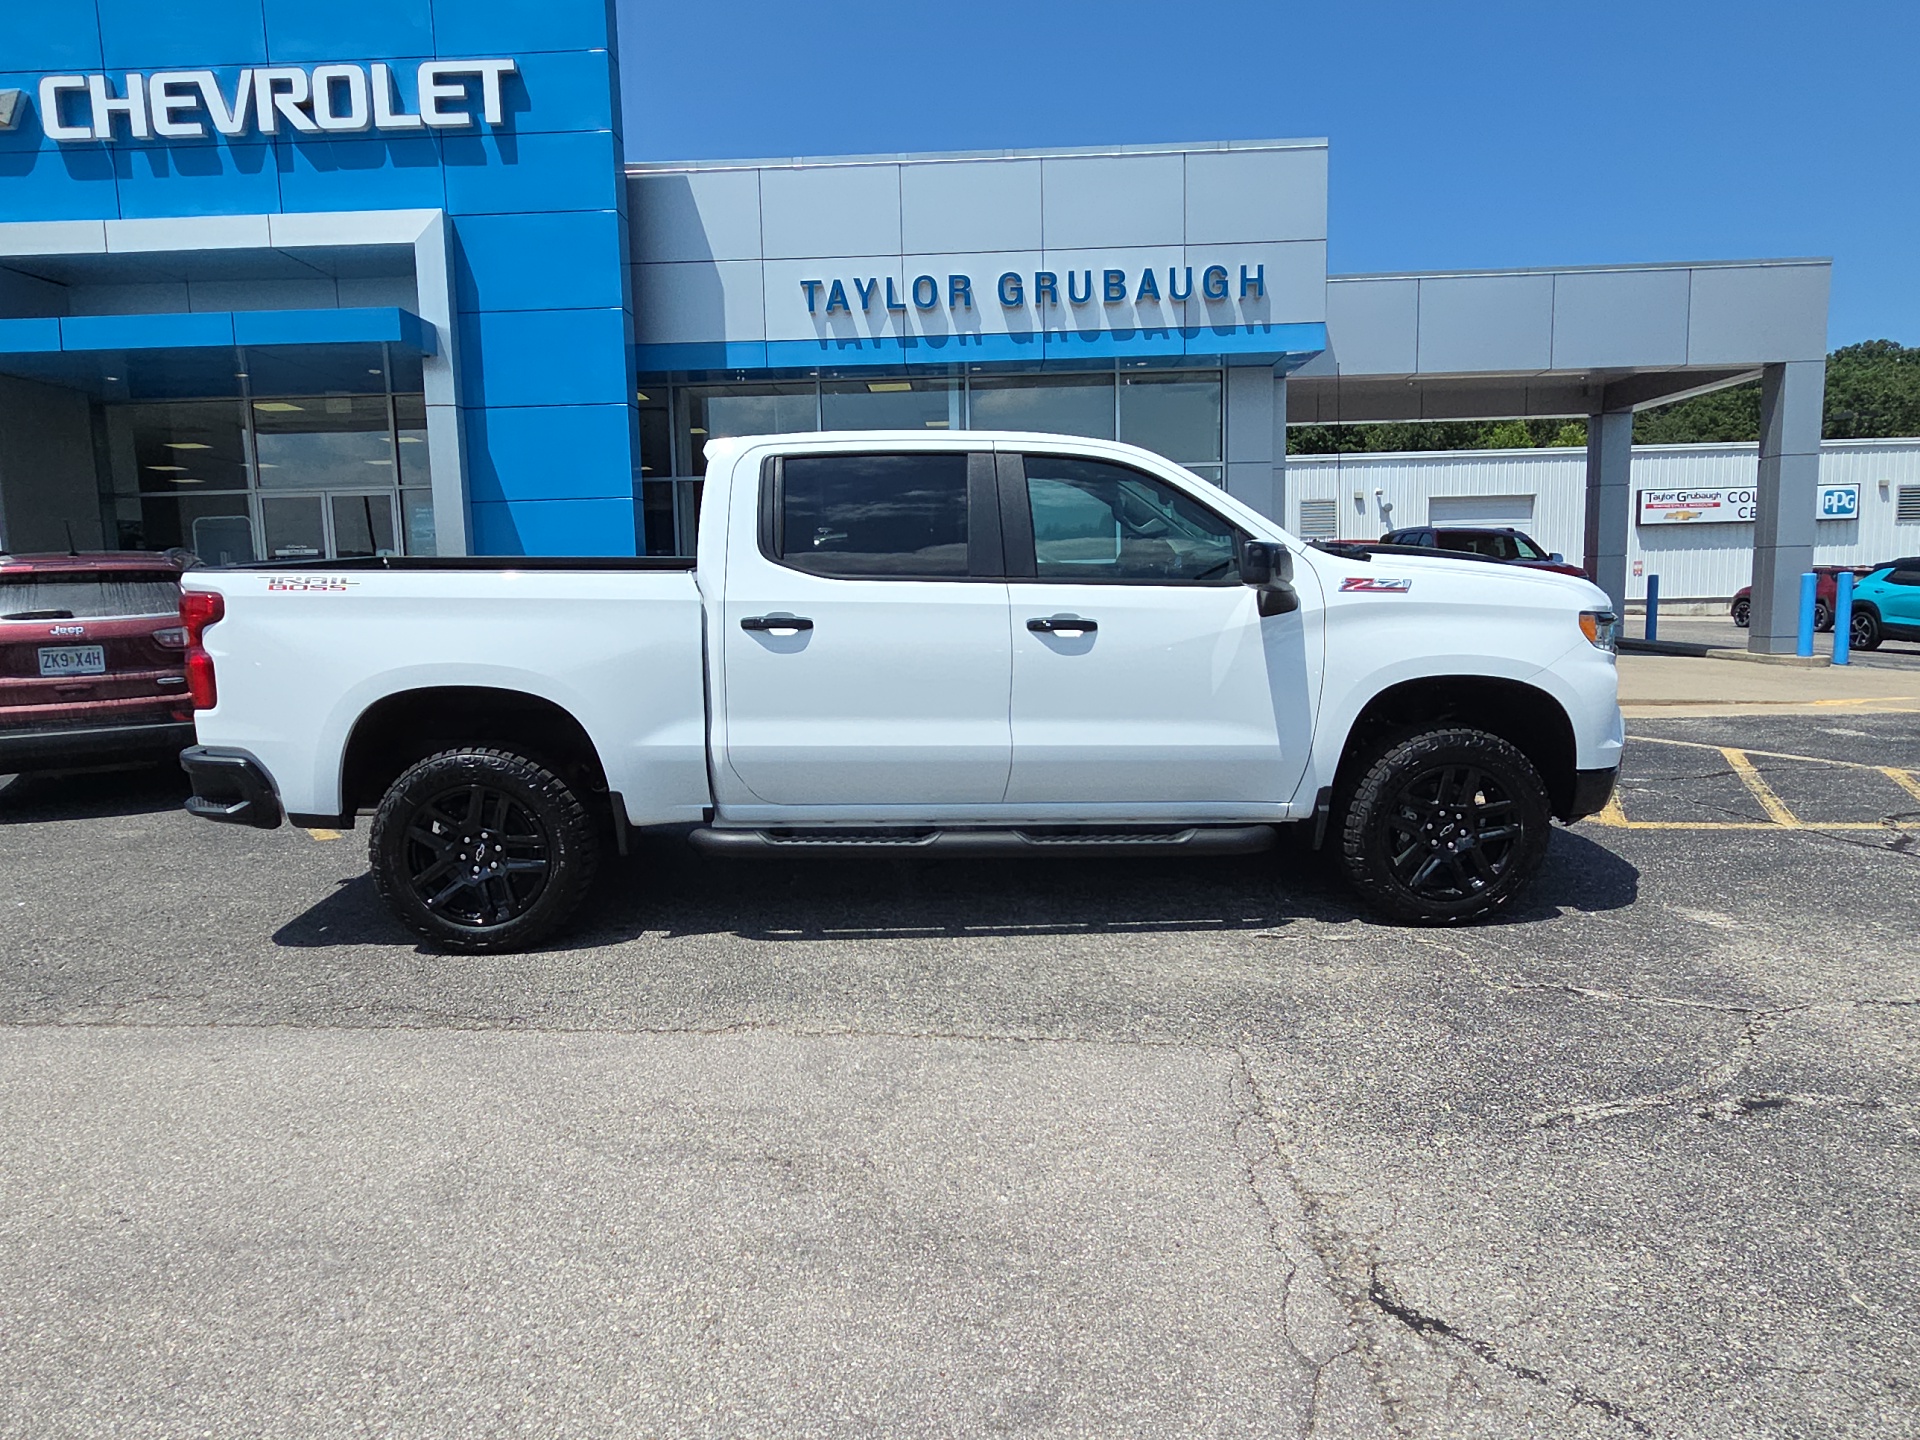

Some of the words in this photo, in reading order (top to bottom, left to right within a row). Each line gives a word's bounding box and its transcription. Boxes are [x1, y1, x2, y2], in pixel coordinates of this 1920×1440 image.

[39, 58, 517, 141] CHEVROLET
[799, 273, 973, 314] TAYLOR
[996, 264, 1266, 308] GRUBAUGH
[1645, 492, 1676, 503] Taylor
[1677, 491, 1722, 502] Grubaugh
[1824, 491, 1855, 513] PPG
[257, 576, 360, 585] TRAIL
[1338, 577, 1412, 594] Z71
[50, 625, 85, 636] Jeep
[42, 653, 69, 669] ZK9
[75, 652, 102, 668] X4H
